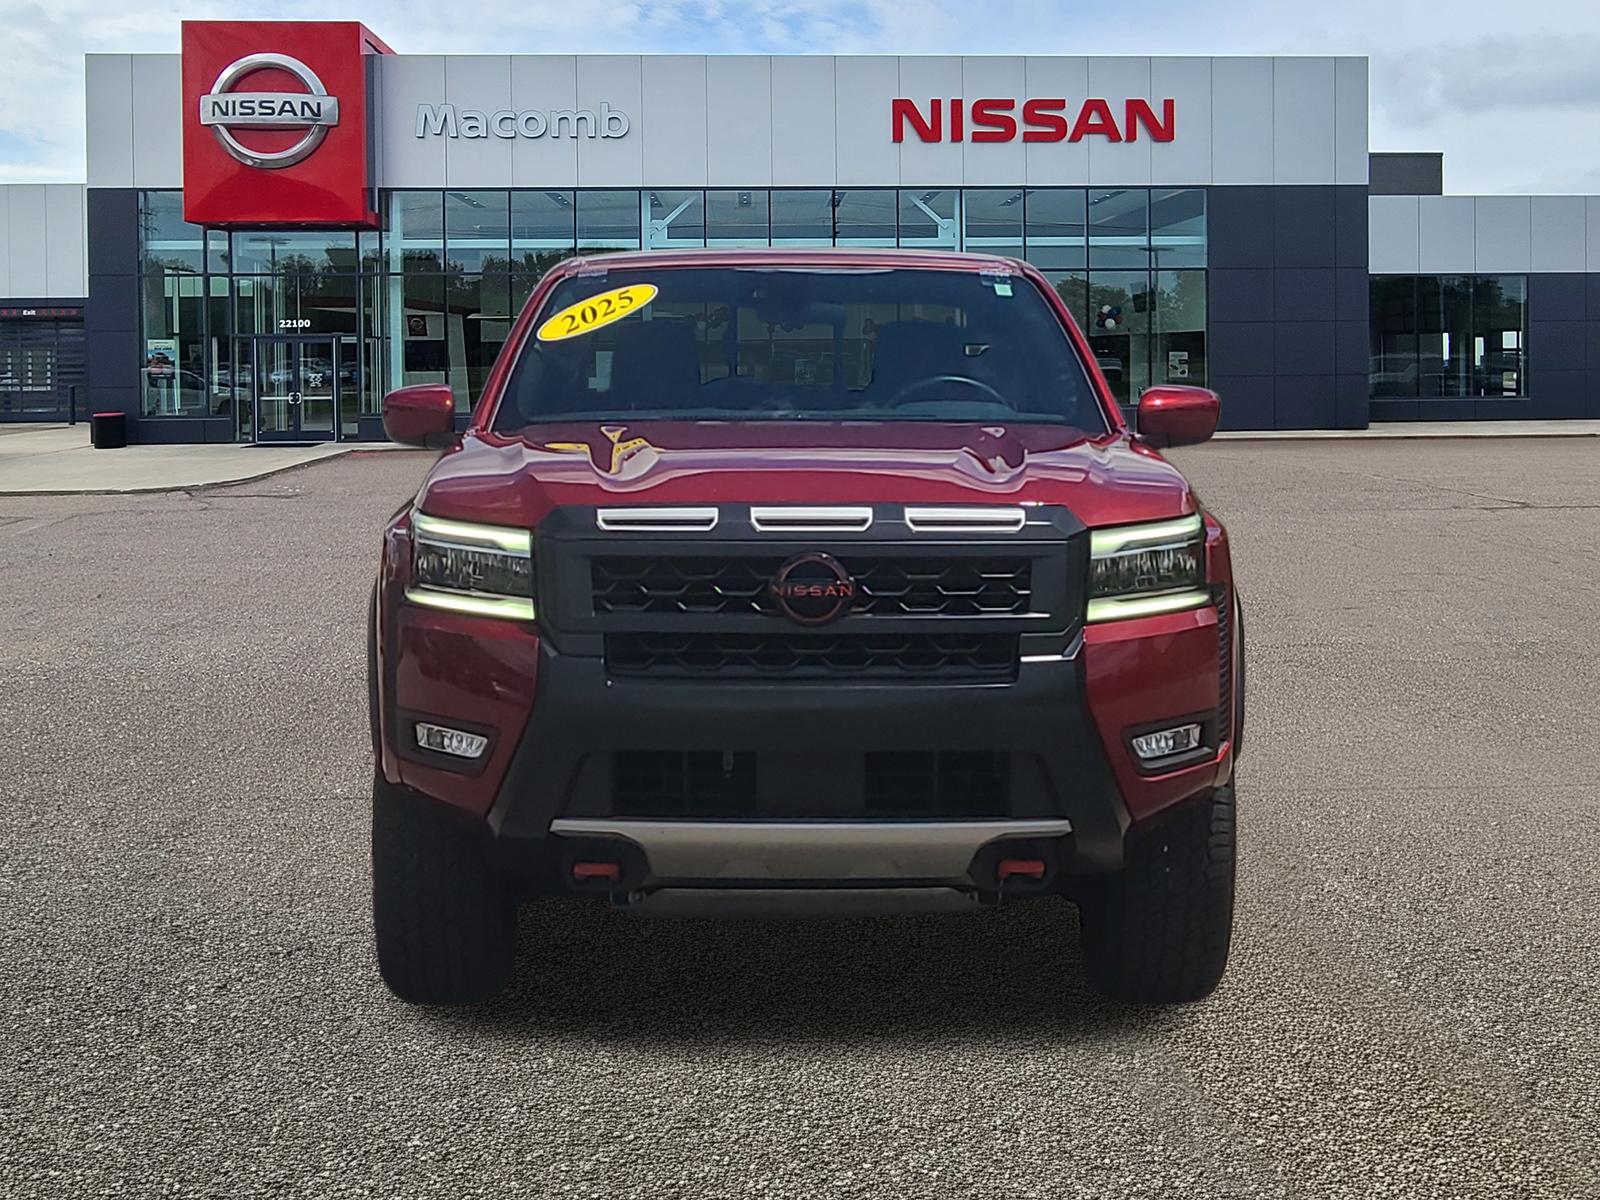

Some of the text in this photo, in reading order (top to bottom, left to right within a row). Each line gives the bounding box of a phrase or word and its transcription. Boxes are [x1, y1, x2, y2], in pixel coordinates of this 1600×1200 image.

[211, 99, 322, 118] NISSAN
[415, 102, 630, 139] Macomb
[892, 98, 1174, 143] NISSAN
[279, 319, 311, 328] 22100
[561, 289, 634, 334] 2025
[771, 584, 853, 597] NISSAN
